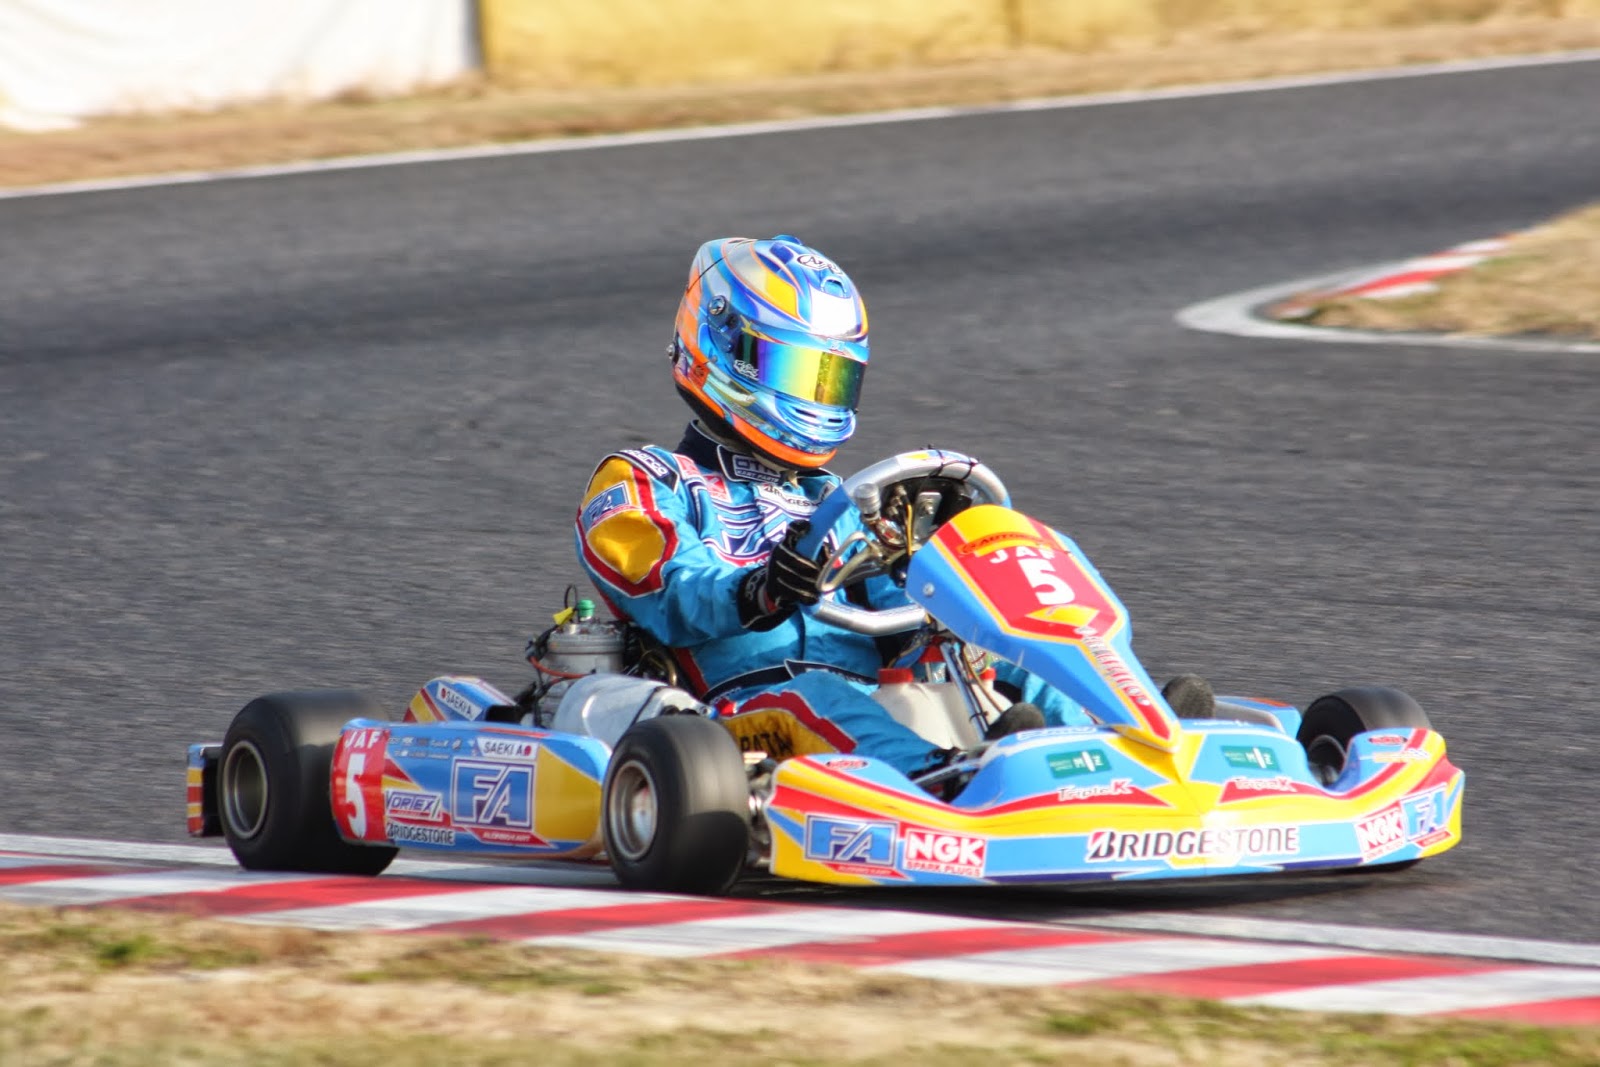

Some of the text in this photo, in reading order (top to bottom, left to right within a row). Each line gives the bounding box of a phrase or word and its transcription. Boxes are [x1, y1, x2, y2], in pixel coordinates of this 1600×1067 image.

[1017, 557, 1076, 606] 5
[344, 730, 380, 749] JAF
[483, 741, 515, 756] SAEKI
[516, 744, 523, 757] A
[346, 753, 367, 838] 5
[454, 760, 535, 829] FA
[387, 823, 454, 845] BRIDGESTONE
[805, 814, 897, 867] FA
[1089, 827, 1298, 860] BRIDGESTONE
[1358, 808, 1403, 850] NGK
[908, 832, 985, 866] NGK
[906, 861, 981, 877] SPARK PLUGS
